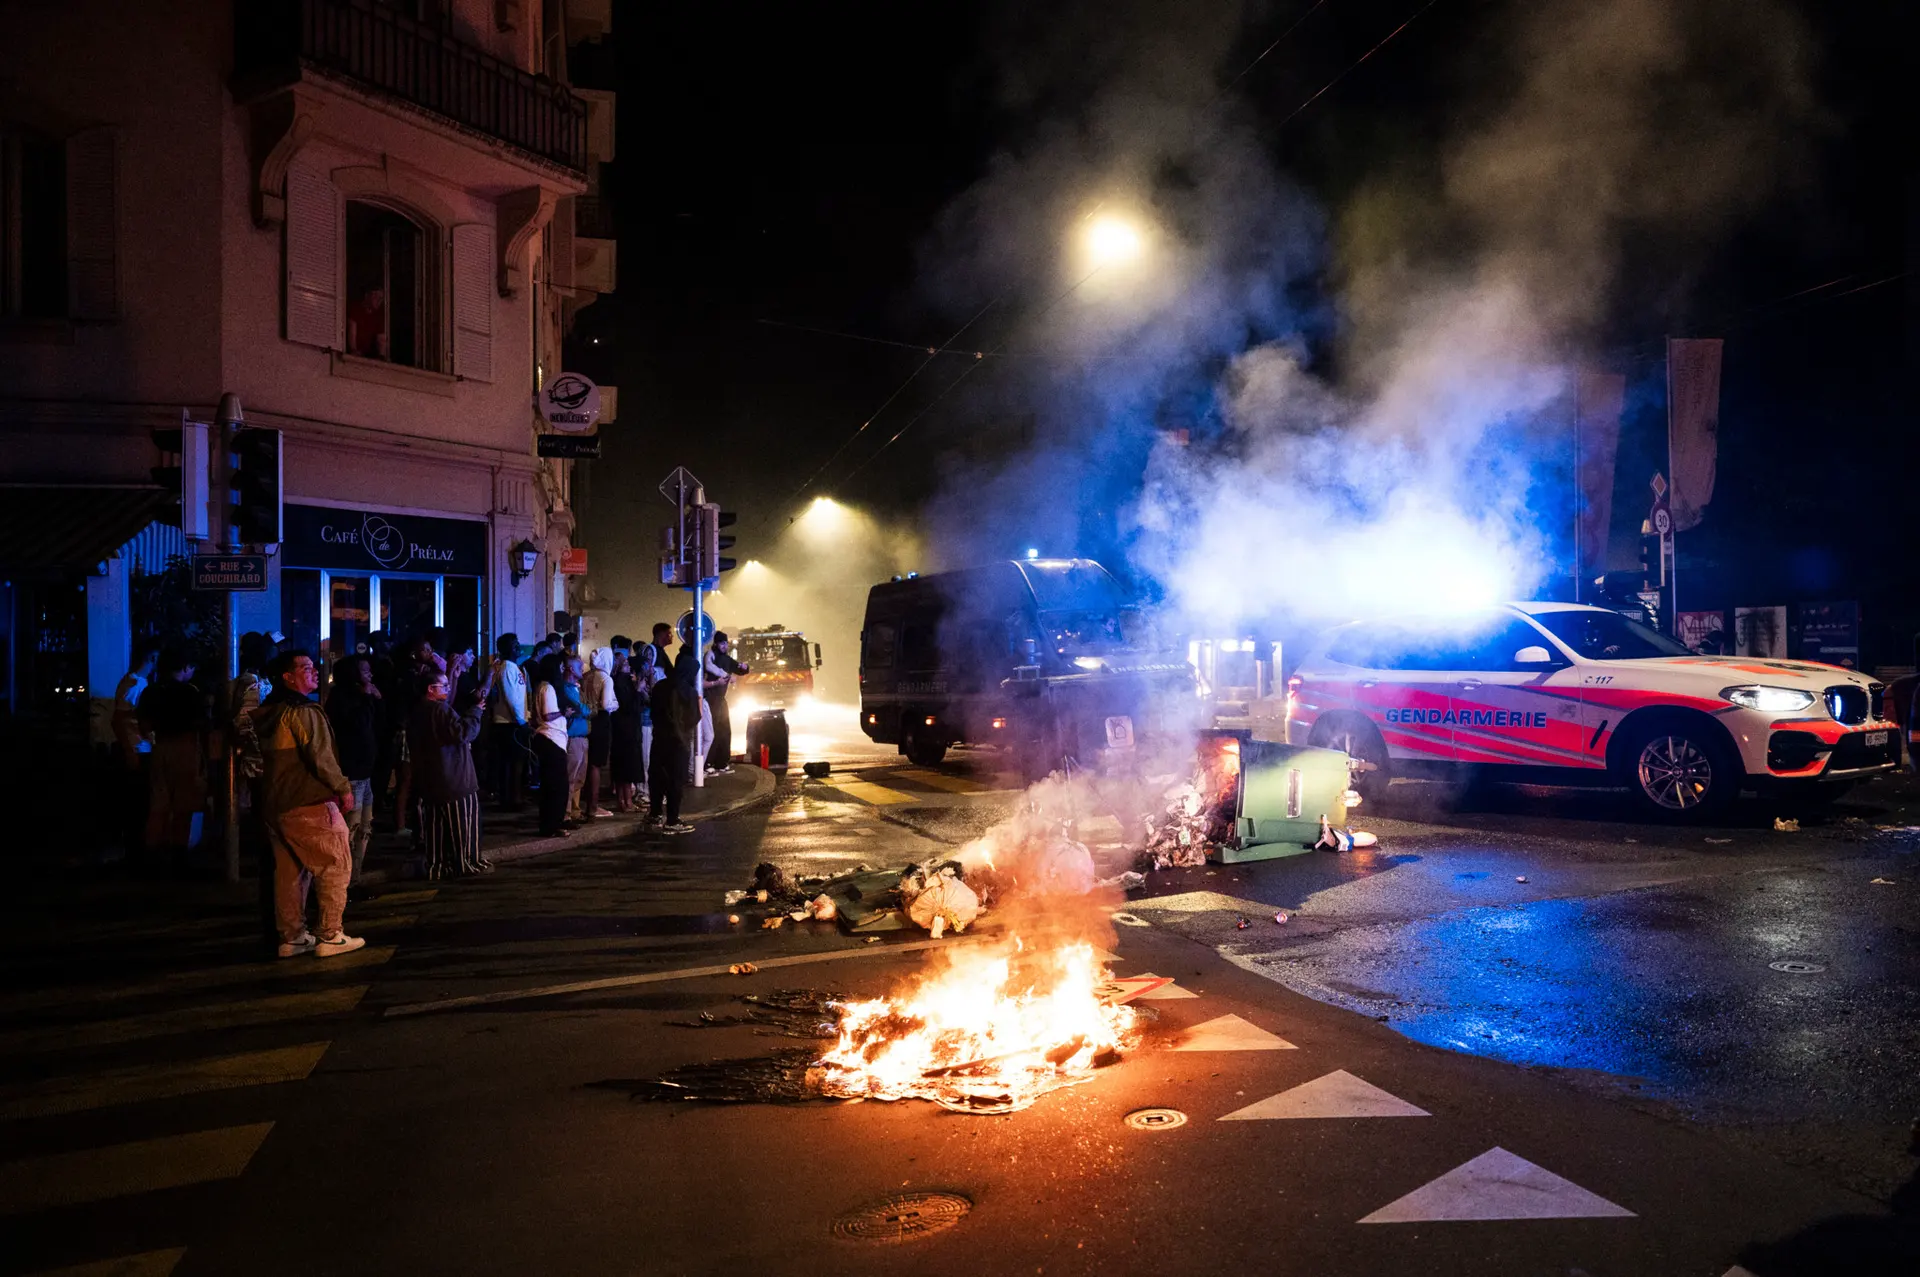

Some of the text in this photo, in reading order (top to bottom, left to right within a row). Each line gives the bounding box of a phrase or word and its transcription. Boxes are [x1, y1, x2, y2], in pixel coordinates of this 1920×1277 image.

[1658, 514, 1668, 528] 30
[378, 540, 391, 551] de
[220, 561, 240, 572] RUE
[199, 573, 261, 584] COUCHIRARD
[1109, 664, 1186, 674] ENDARMERIE
[1595, 675, 1614, 684] 117
[1386, 708, 1547, 729] GENDARMERIE
